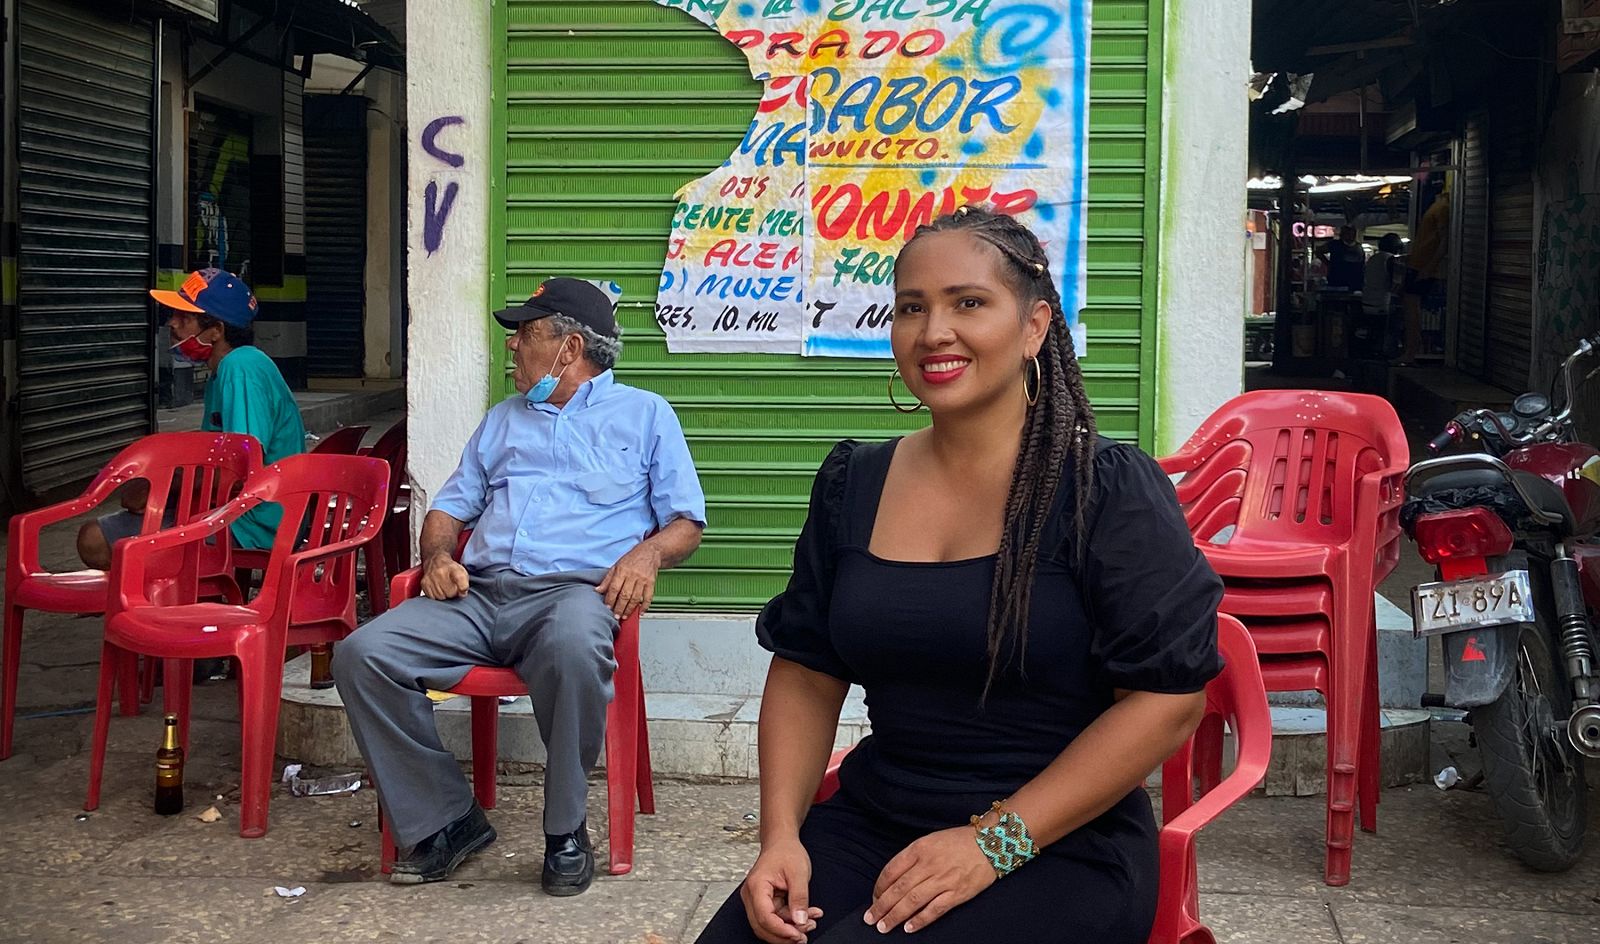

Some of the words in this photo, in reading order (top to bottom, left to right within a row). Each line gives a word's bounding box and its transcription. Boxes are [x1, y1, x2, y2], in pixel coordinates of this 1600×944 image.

[809, 66, 1021, 135] SABOR
[809, 137, 949, 160] NVICTO.
[695, 273, 803, 303] MUJE
[746, 310, 780, 332] MIL
